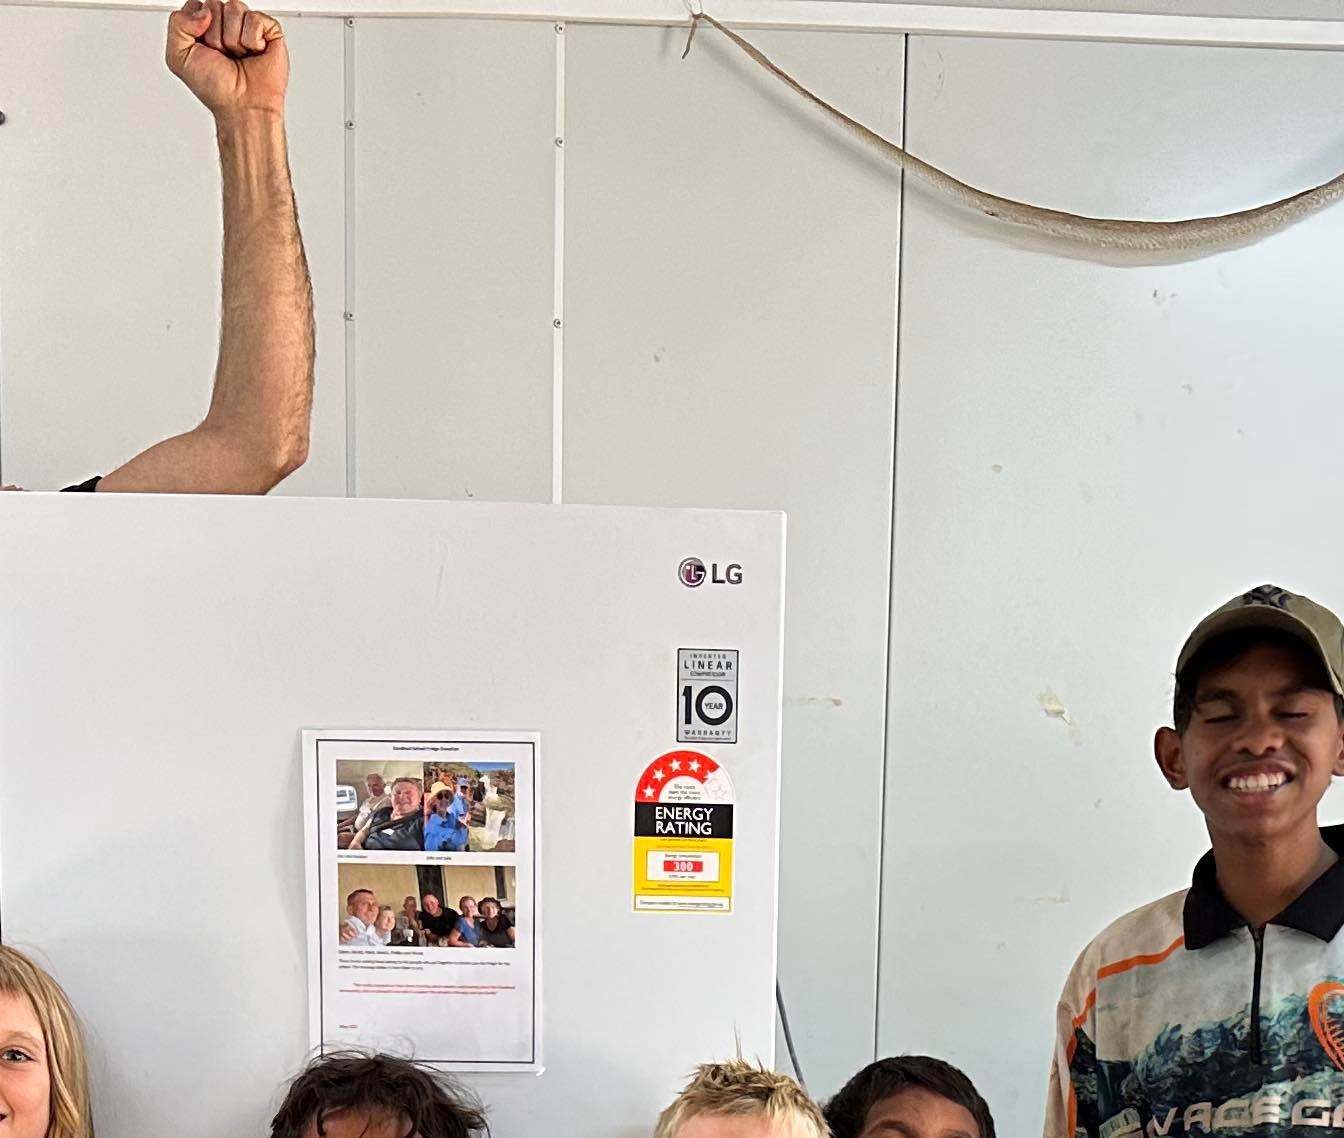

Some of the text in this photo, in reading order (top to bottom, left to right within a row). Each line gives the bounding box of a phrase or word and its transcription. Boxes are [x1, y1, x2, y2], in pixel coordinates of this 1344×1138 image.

[712, 563, 743, 585] LG
[684, 660, 733, 671] LINEAR
[682, 685, 733, 726] 10
[704, 702, 724, 710] YEAR
[655, 806, 714, 821] ENERGY
[655, 821, 712, 835] RATING
